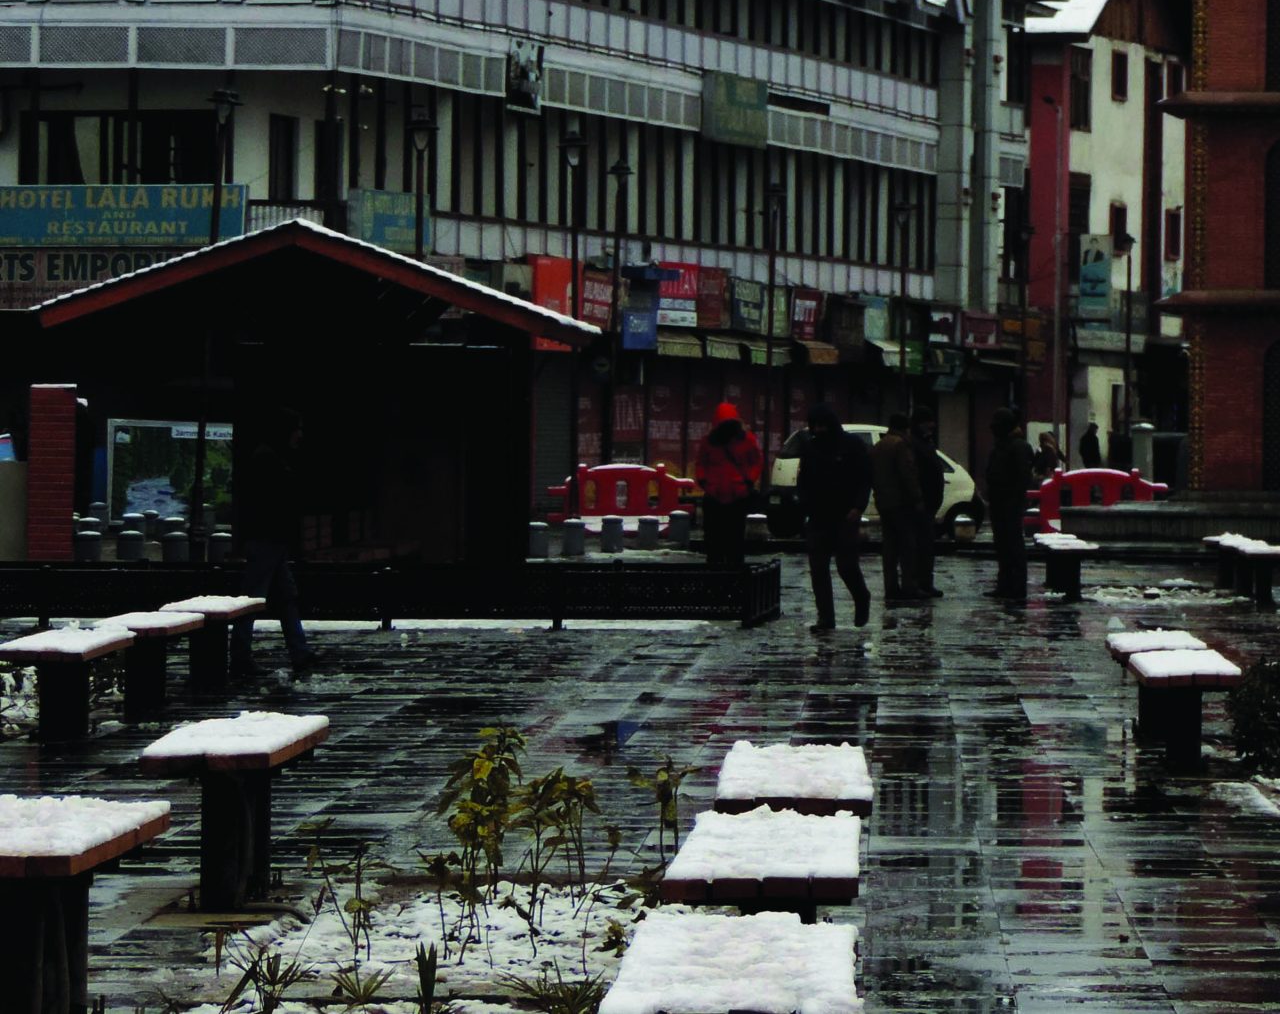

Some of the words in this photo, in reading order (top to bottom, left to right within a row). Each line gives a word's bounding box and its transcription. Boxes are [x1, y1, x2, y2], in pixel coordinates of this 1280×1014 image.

[0, 189, 74, 210] HOTEL
[86, 187, 149, 209] LALA
[161, 187, 240, 210] RUKH
[103, 211, 136, 219] AND
[47, 221, 189, 235] RESTAURANT
[0, 253, 34, 281] TS
[47, 253, 176, 281] EMPOR
